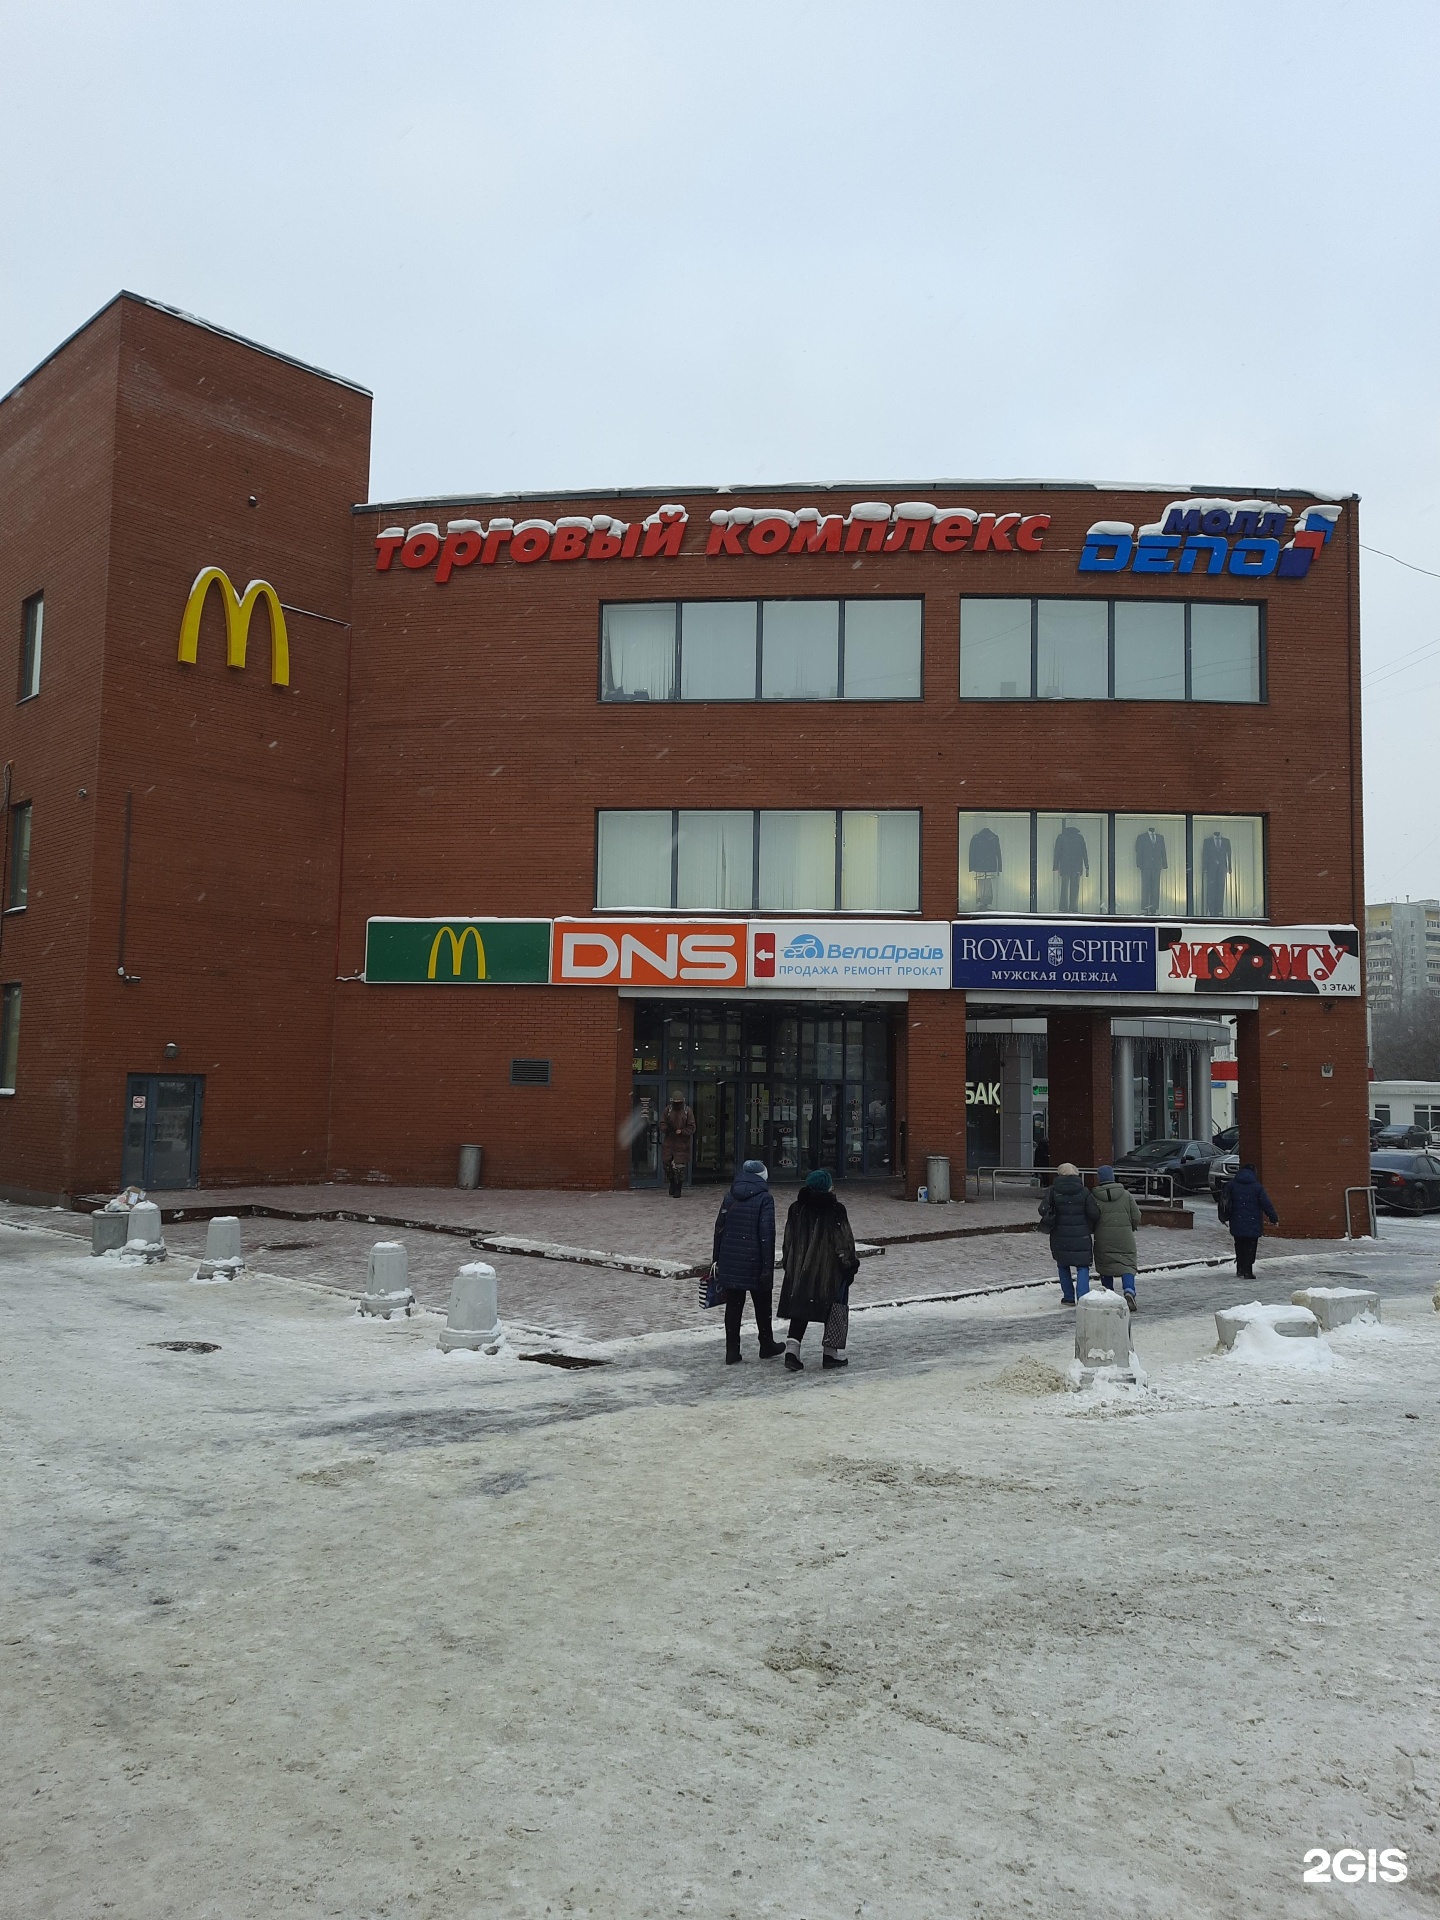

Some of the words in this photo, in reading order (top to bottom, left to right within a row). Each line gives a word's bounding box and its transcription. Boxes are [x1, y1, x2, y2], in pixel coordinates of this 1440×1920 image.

[561, 932, 738, 981] DNS
[826, 944, 945, 963] ВелоДрайв
[961, 938, 1041, 962] ROYAL
[1071, 939, 1148, 963] SPIRIT
[779, 965, 839, 978] ПРОДАЖА
[844, 966, 893, 976] РЕМОНТ
[897, 966, 944, 976] ПРОКАТ
[991, 970, 1057, 981] МУЖСКАЯ
[1062, 971, 1118, 983] ОДЕЖДА
[1322, 983, 1328, 991] 3
[1329, 983, 1357, 992] ЭТАЖ
